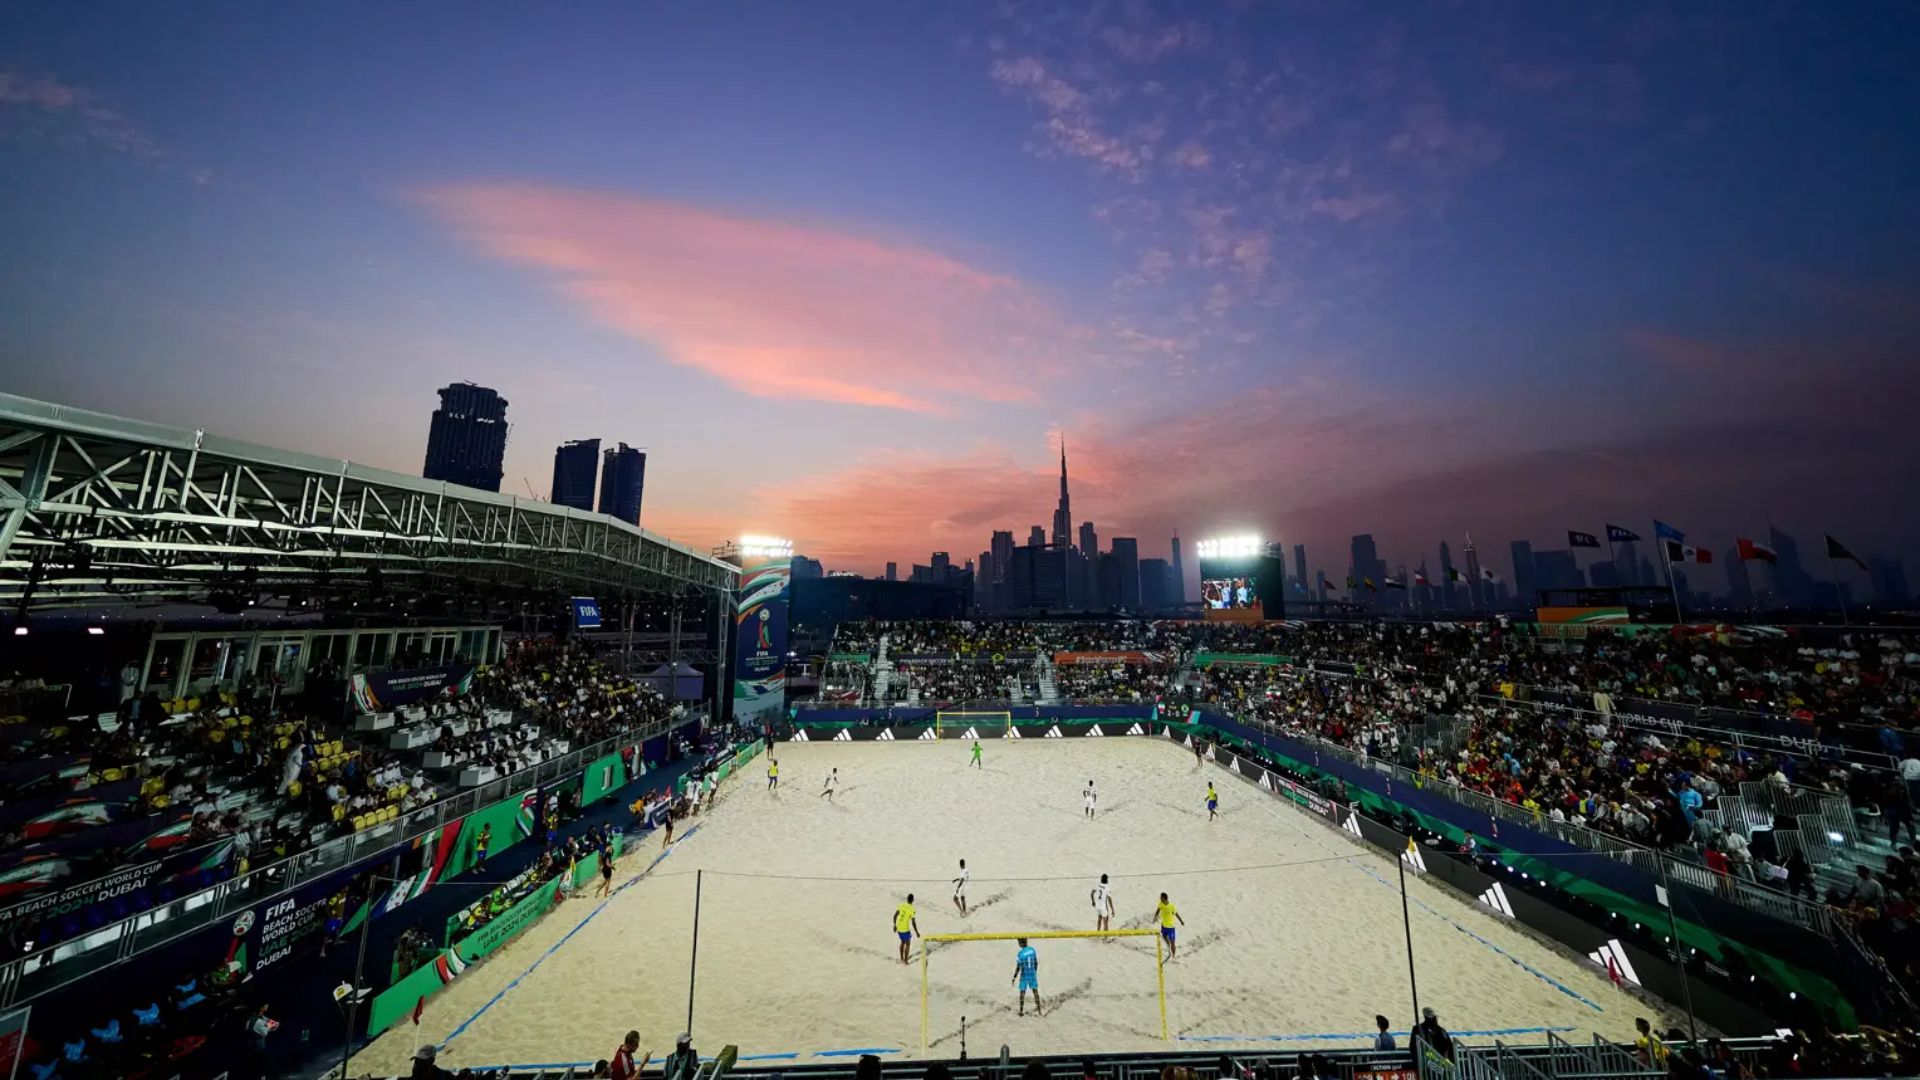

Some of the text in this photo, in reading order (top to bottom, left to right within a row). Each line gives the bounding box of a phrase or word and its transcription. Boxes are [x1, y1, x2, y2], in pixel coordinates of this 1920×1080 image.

[579, 605, 598, 617] FIFA
[16, 896, 57, 917] BEACH
[58, 882, 101, 903] SOCCER
[103, 870, 143, 888] WORLD
[143, 863, 163, 876] CUP
[46, 894, 94, 918] 2024
[98, 877, 149, 902] DUBAI
[1098, 889, 1103, 899] 2
[265, 898, 295, 921] FIFA
[262, 912, 315, 943] WORLD CUP
[263, 913, 293, 934] BEACH
[256, 945, 292, 970] DUBAI
[258, 935, 289, 958] UAE
